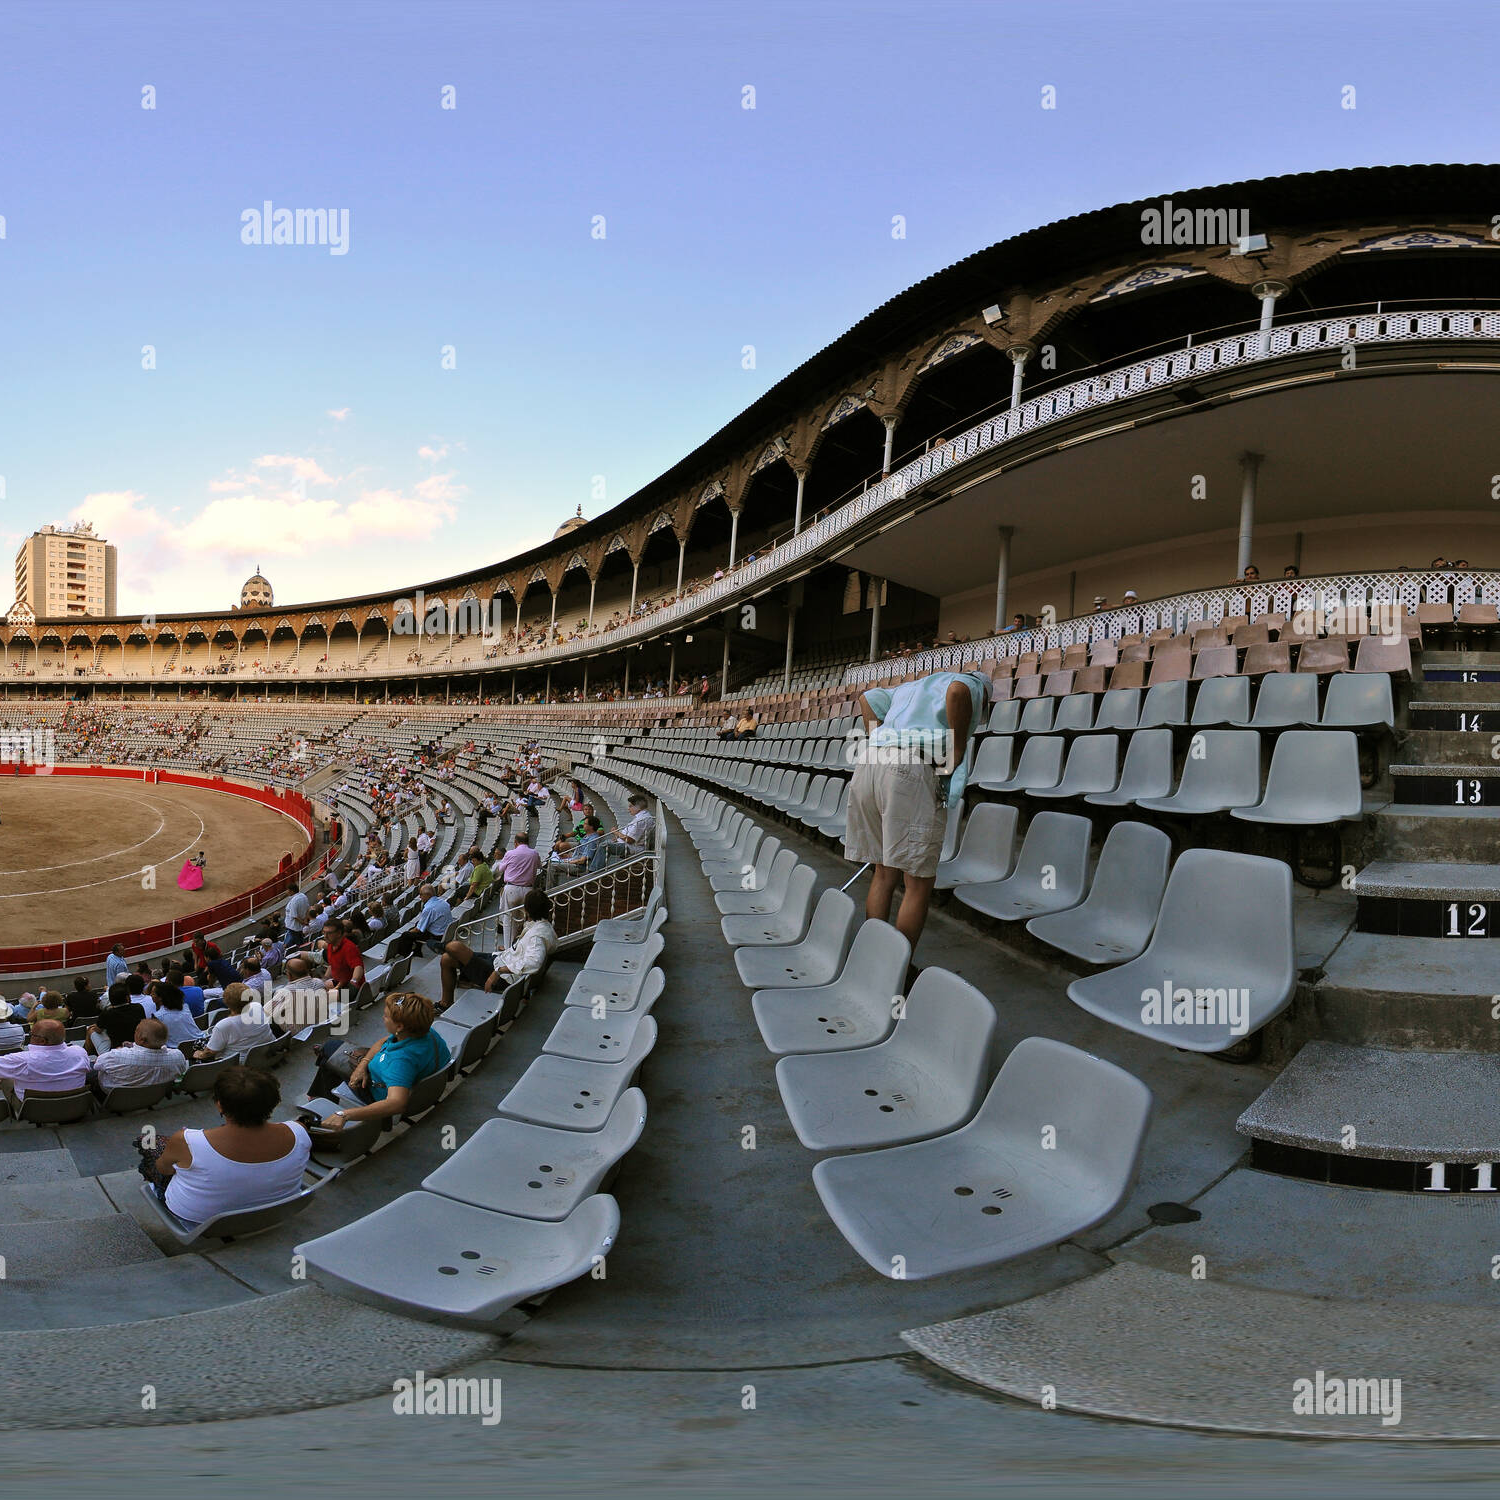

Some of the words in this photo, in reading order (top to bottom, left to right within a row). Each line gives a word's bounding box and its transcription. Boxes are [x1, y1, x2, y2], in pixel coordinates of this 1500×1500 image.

[1462, 672, 1478, 682] 15
[1459, 713, 1481, 732] 14
[1455, 779, 1482, 804] 13
[1446, 903, 1487, 936] 12
[1423, 1162, 1498, 1191] 11
